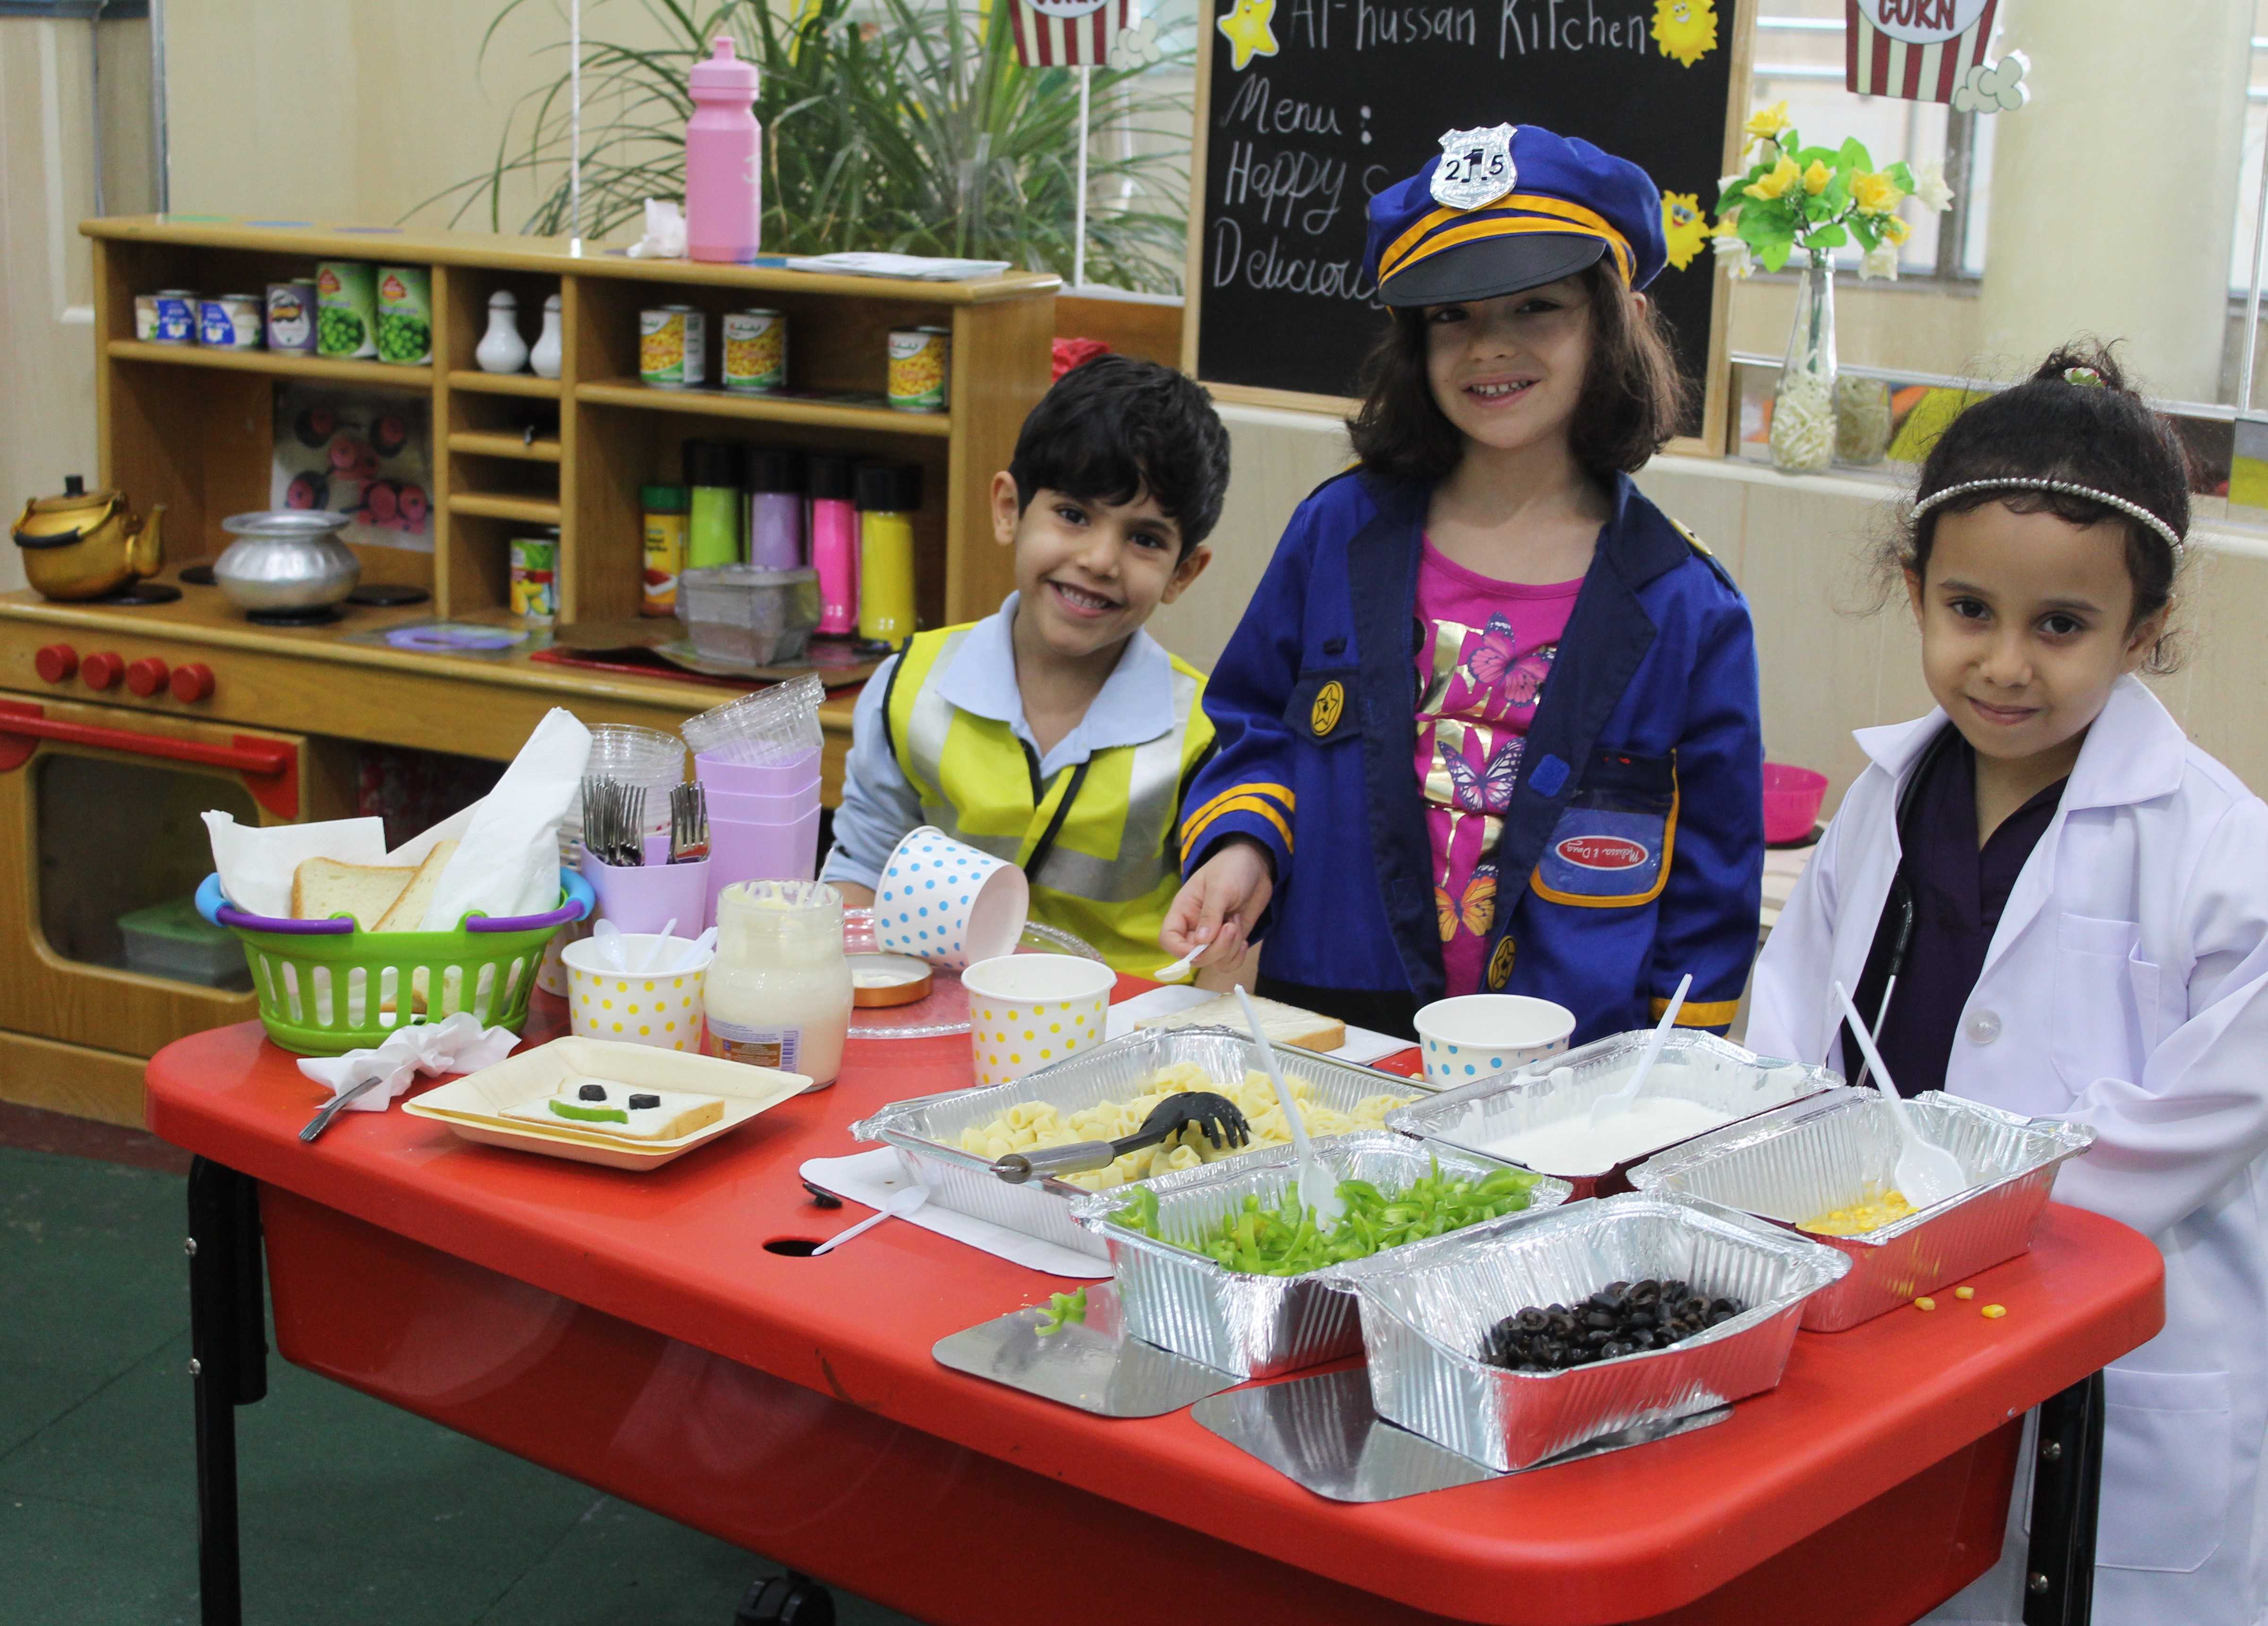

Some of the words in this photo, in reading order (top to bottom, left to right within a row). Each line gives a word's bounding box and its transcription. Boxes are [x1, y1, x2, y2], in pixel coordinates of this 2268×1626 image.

[1224, 140, 1347, 235] Happy
[1213, 216, 1386, 310] Deliciou
[1601, 846, 1640, 863] Melissa
